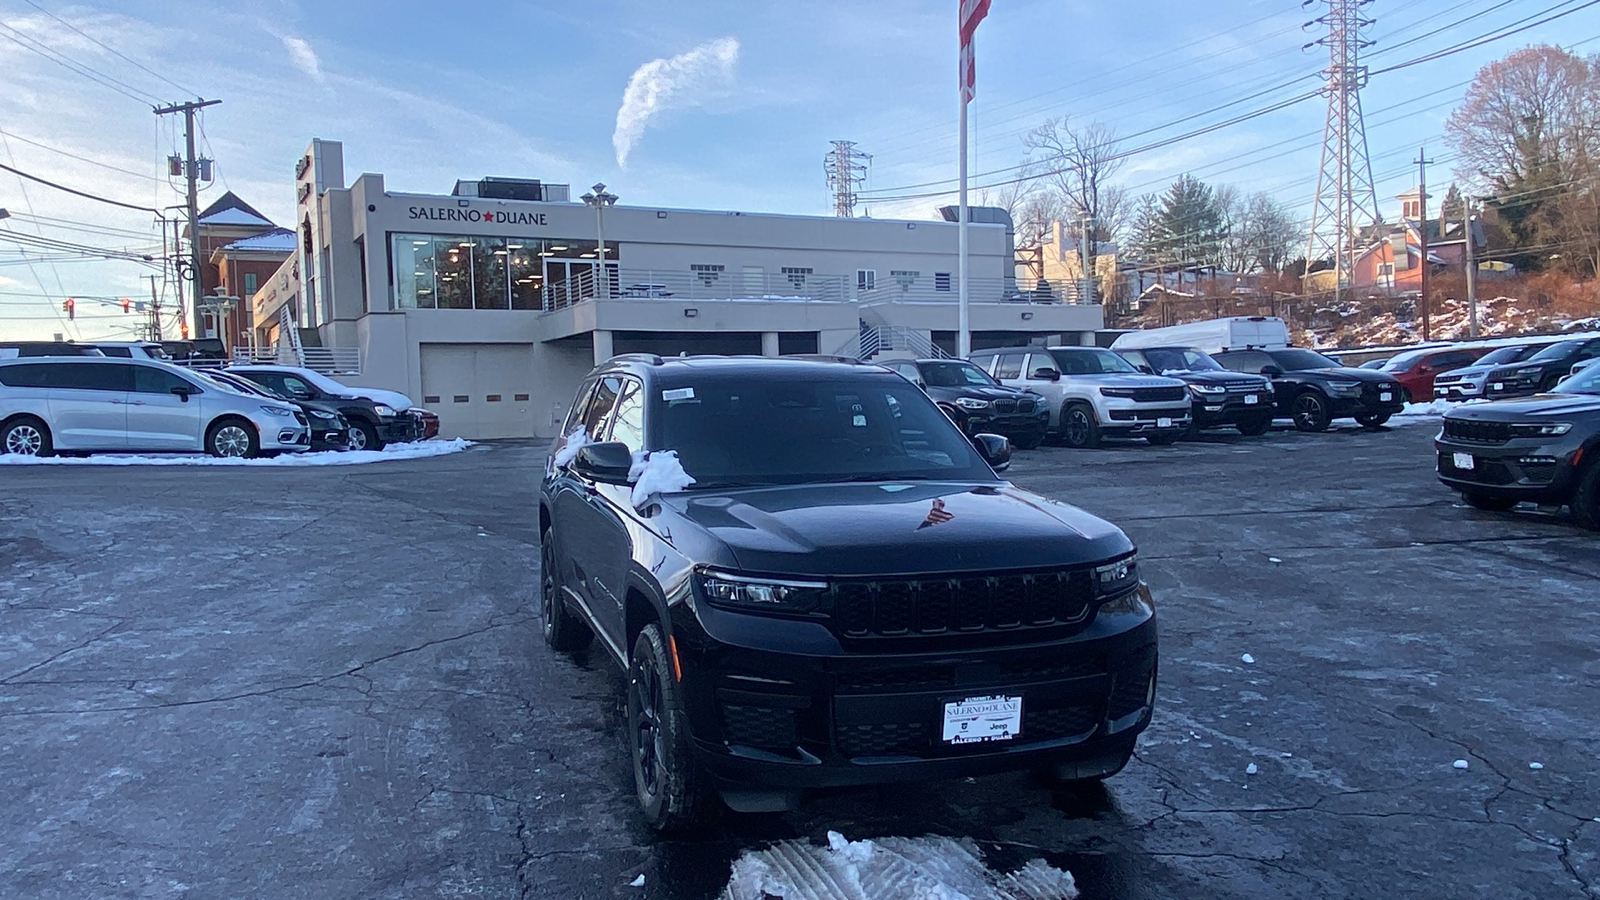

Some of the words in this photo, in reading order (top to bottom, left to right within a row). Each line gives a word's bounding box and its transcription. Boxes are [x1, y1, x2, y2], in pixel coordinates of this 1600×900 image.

[409, 207, 481, 222] SALERNO
[496, 211, 548, 225] DUANE
[947, 706, 984, 715] SALERNO
[989, 703, 1018, 711] DUANE
[989, 723, 1008, 731] Jeep
